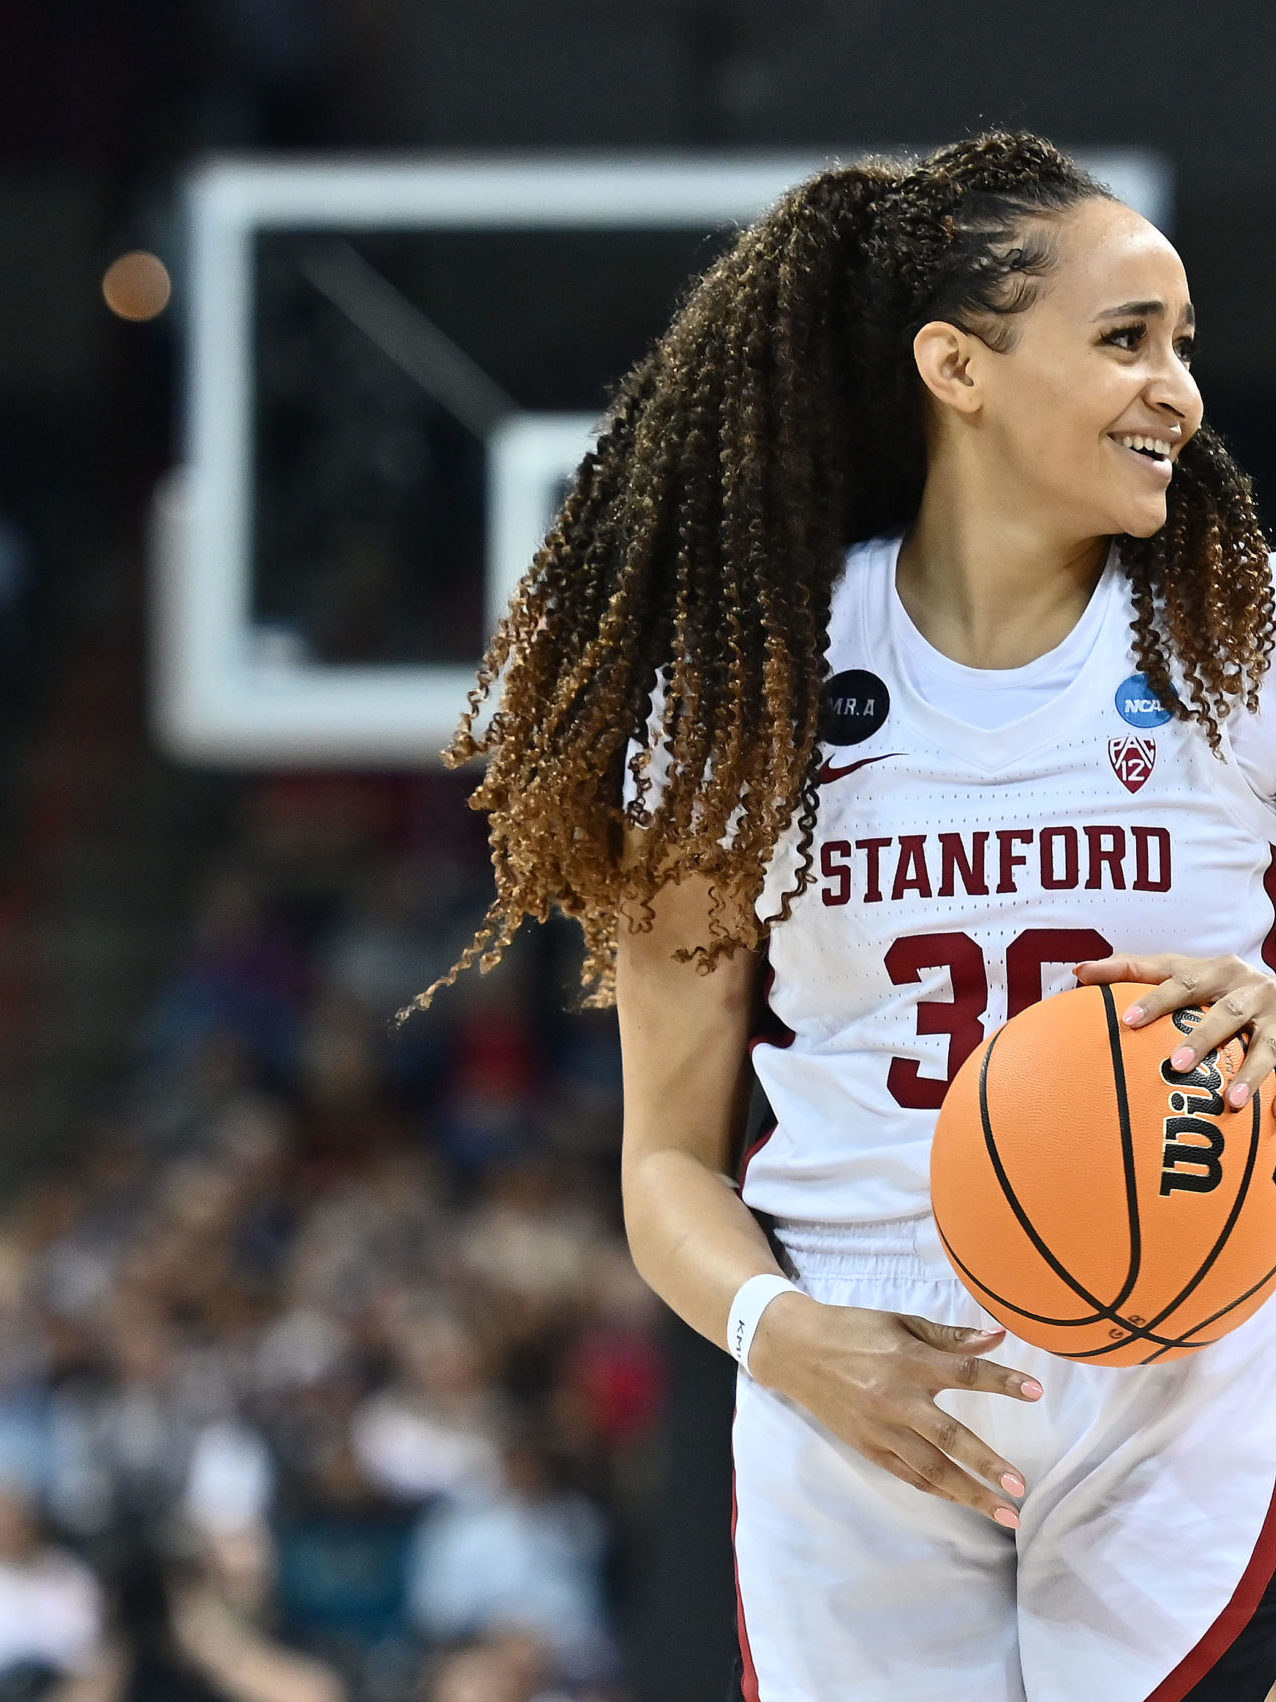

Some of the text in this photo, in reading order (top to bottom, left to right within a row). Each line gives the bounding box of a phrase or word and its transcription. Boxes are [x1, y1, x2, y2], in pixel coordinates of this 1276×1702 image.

[1124, 698, 1167, 714] NCA
[1109, 737, 1156, 770] PAC
[1120, 758, 1146, 781] 12
[820, 825, 1173, 907] STANFORD
[1158, 1004, 1226, 1198] Wilo
